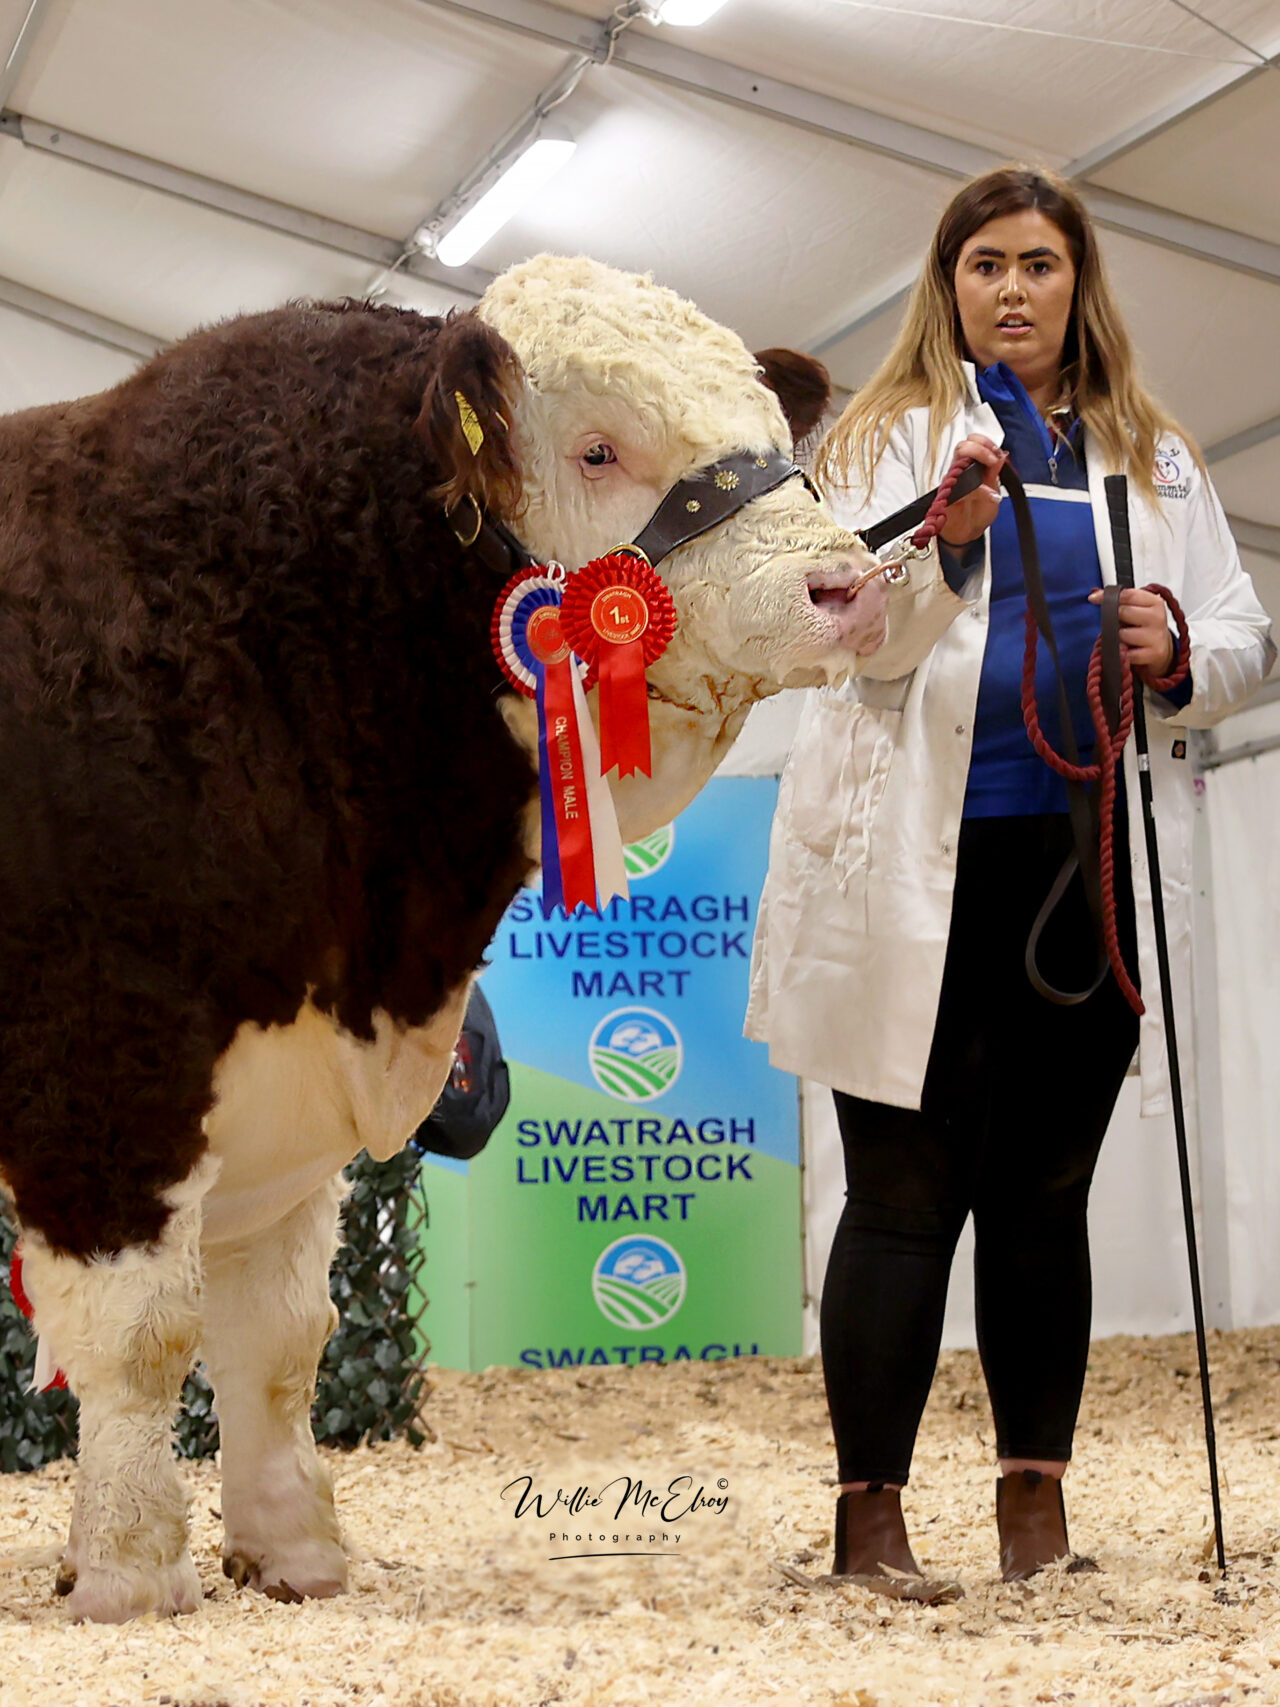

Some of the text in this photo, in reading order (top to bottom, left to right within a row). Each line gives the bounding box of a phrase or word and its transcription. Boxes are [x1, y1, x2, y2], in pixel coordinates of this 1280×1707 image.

[609, 605, 630, 625] 1st
[555, 716, 579, 820] CHAMPION MALE
[509, 895, 750, 922] SWATRAGH
[509, 930, 749, 960] LIVESTOCK
[572, 970, 691, 998] MART
[516, 1117, 756, 1147] SWATRAGH
[516, 1153, 754, 1184] LIVESTOCK
[577, 1193, 696, 1222] MART
